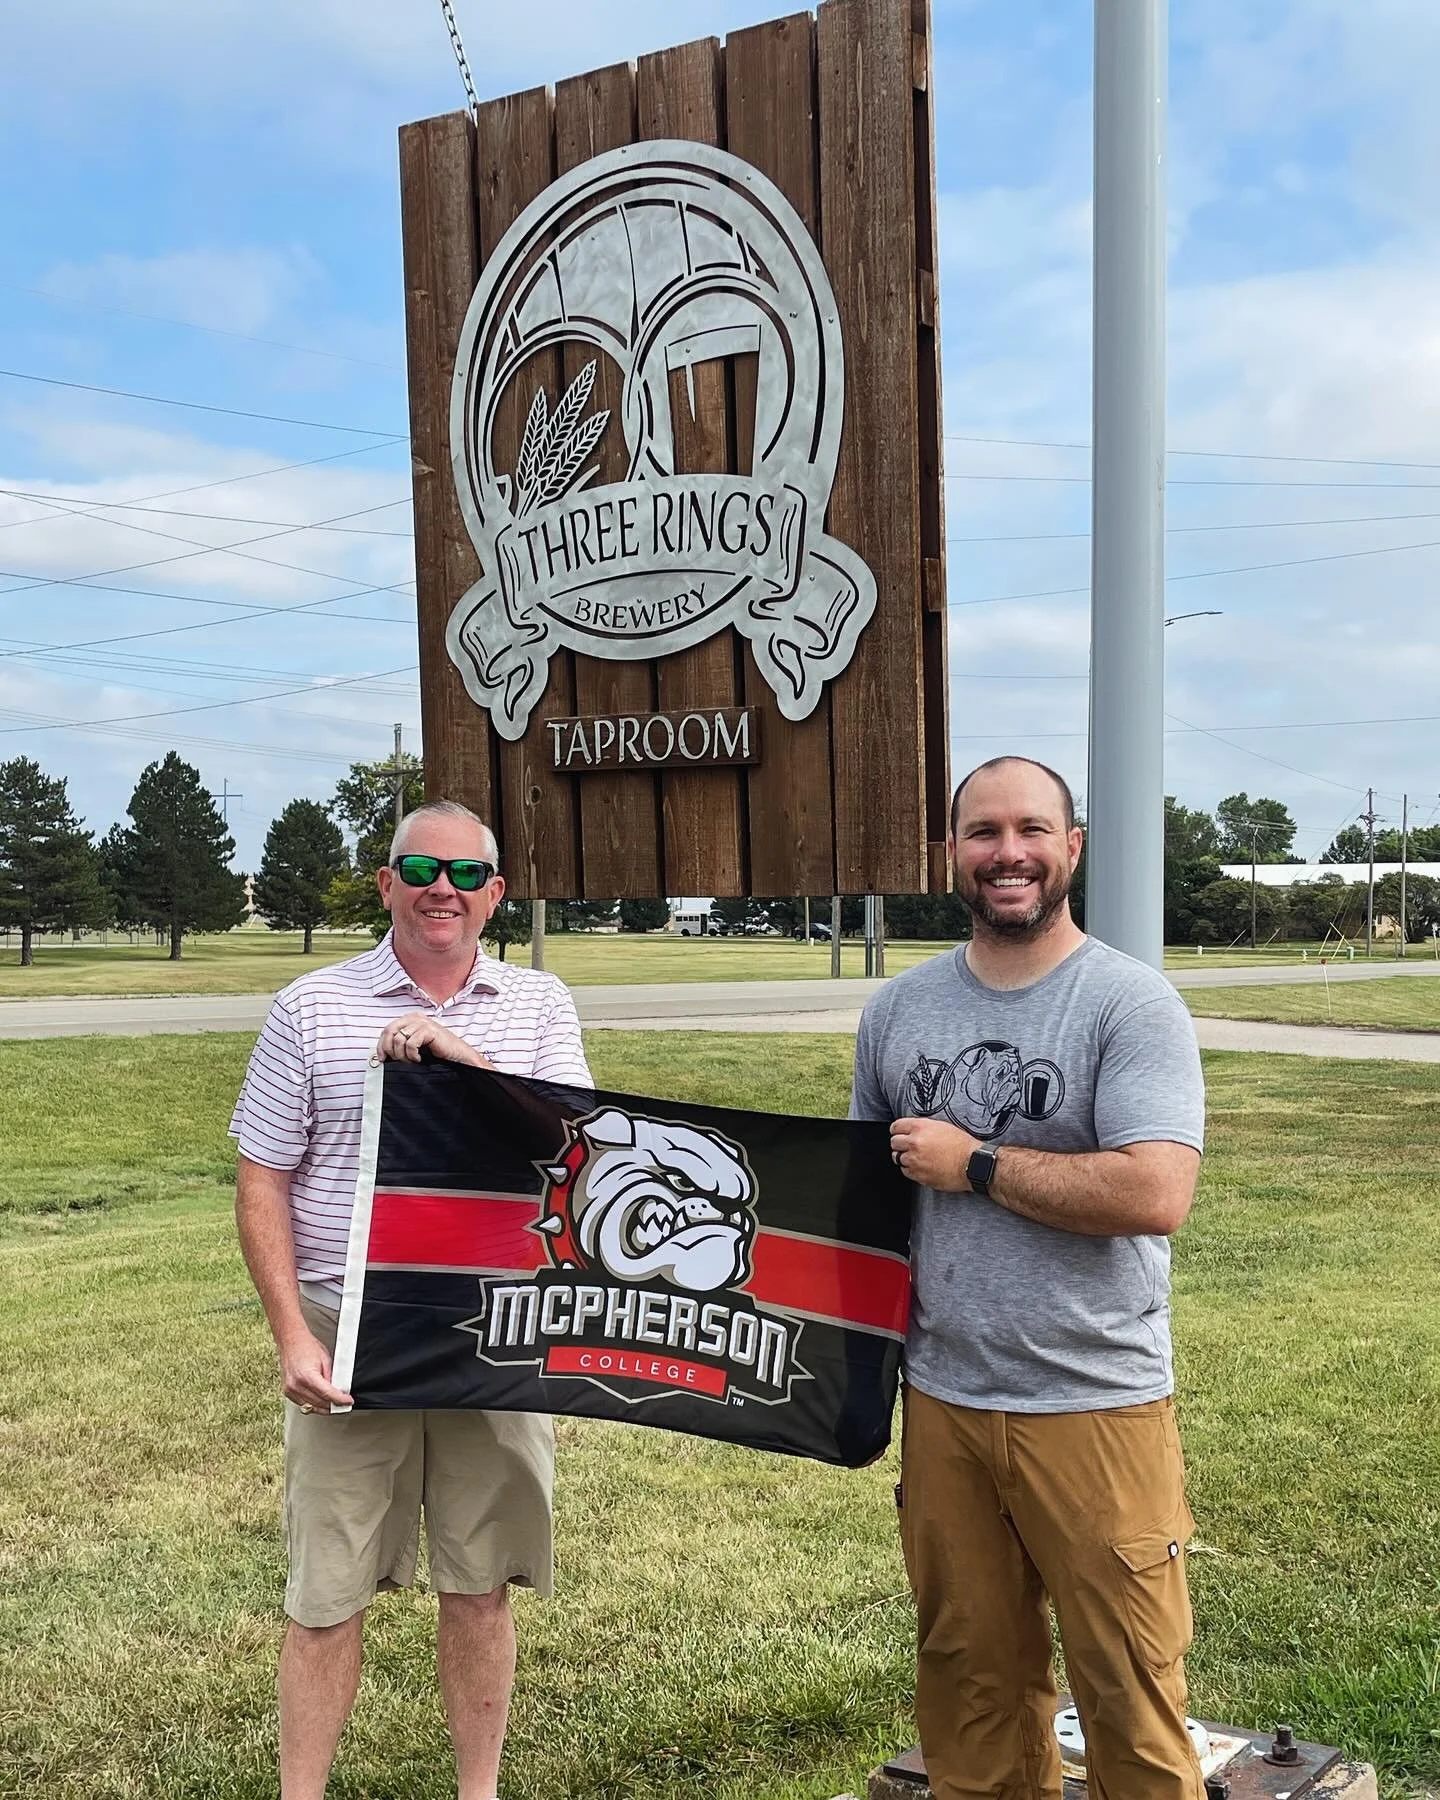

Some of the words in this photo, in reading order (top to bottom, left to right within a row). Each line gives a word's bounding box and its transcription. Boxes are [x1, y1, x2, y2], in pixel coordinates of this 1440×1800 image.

[519, 498, 640, 584] THREE
[652, 490, 775, 556] RINGS
[575, 583, 708, 629] BREWERY
[546, 711, 751, 767] TAPROOM
[488, 1285, 788, 1388] MCPHERSON
[579, 1353, 697, 1383] COLLEGE
